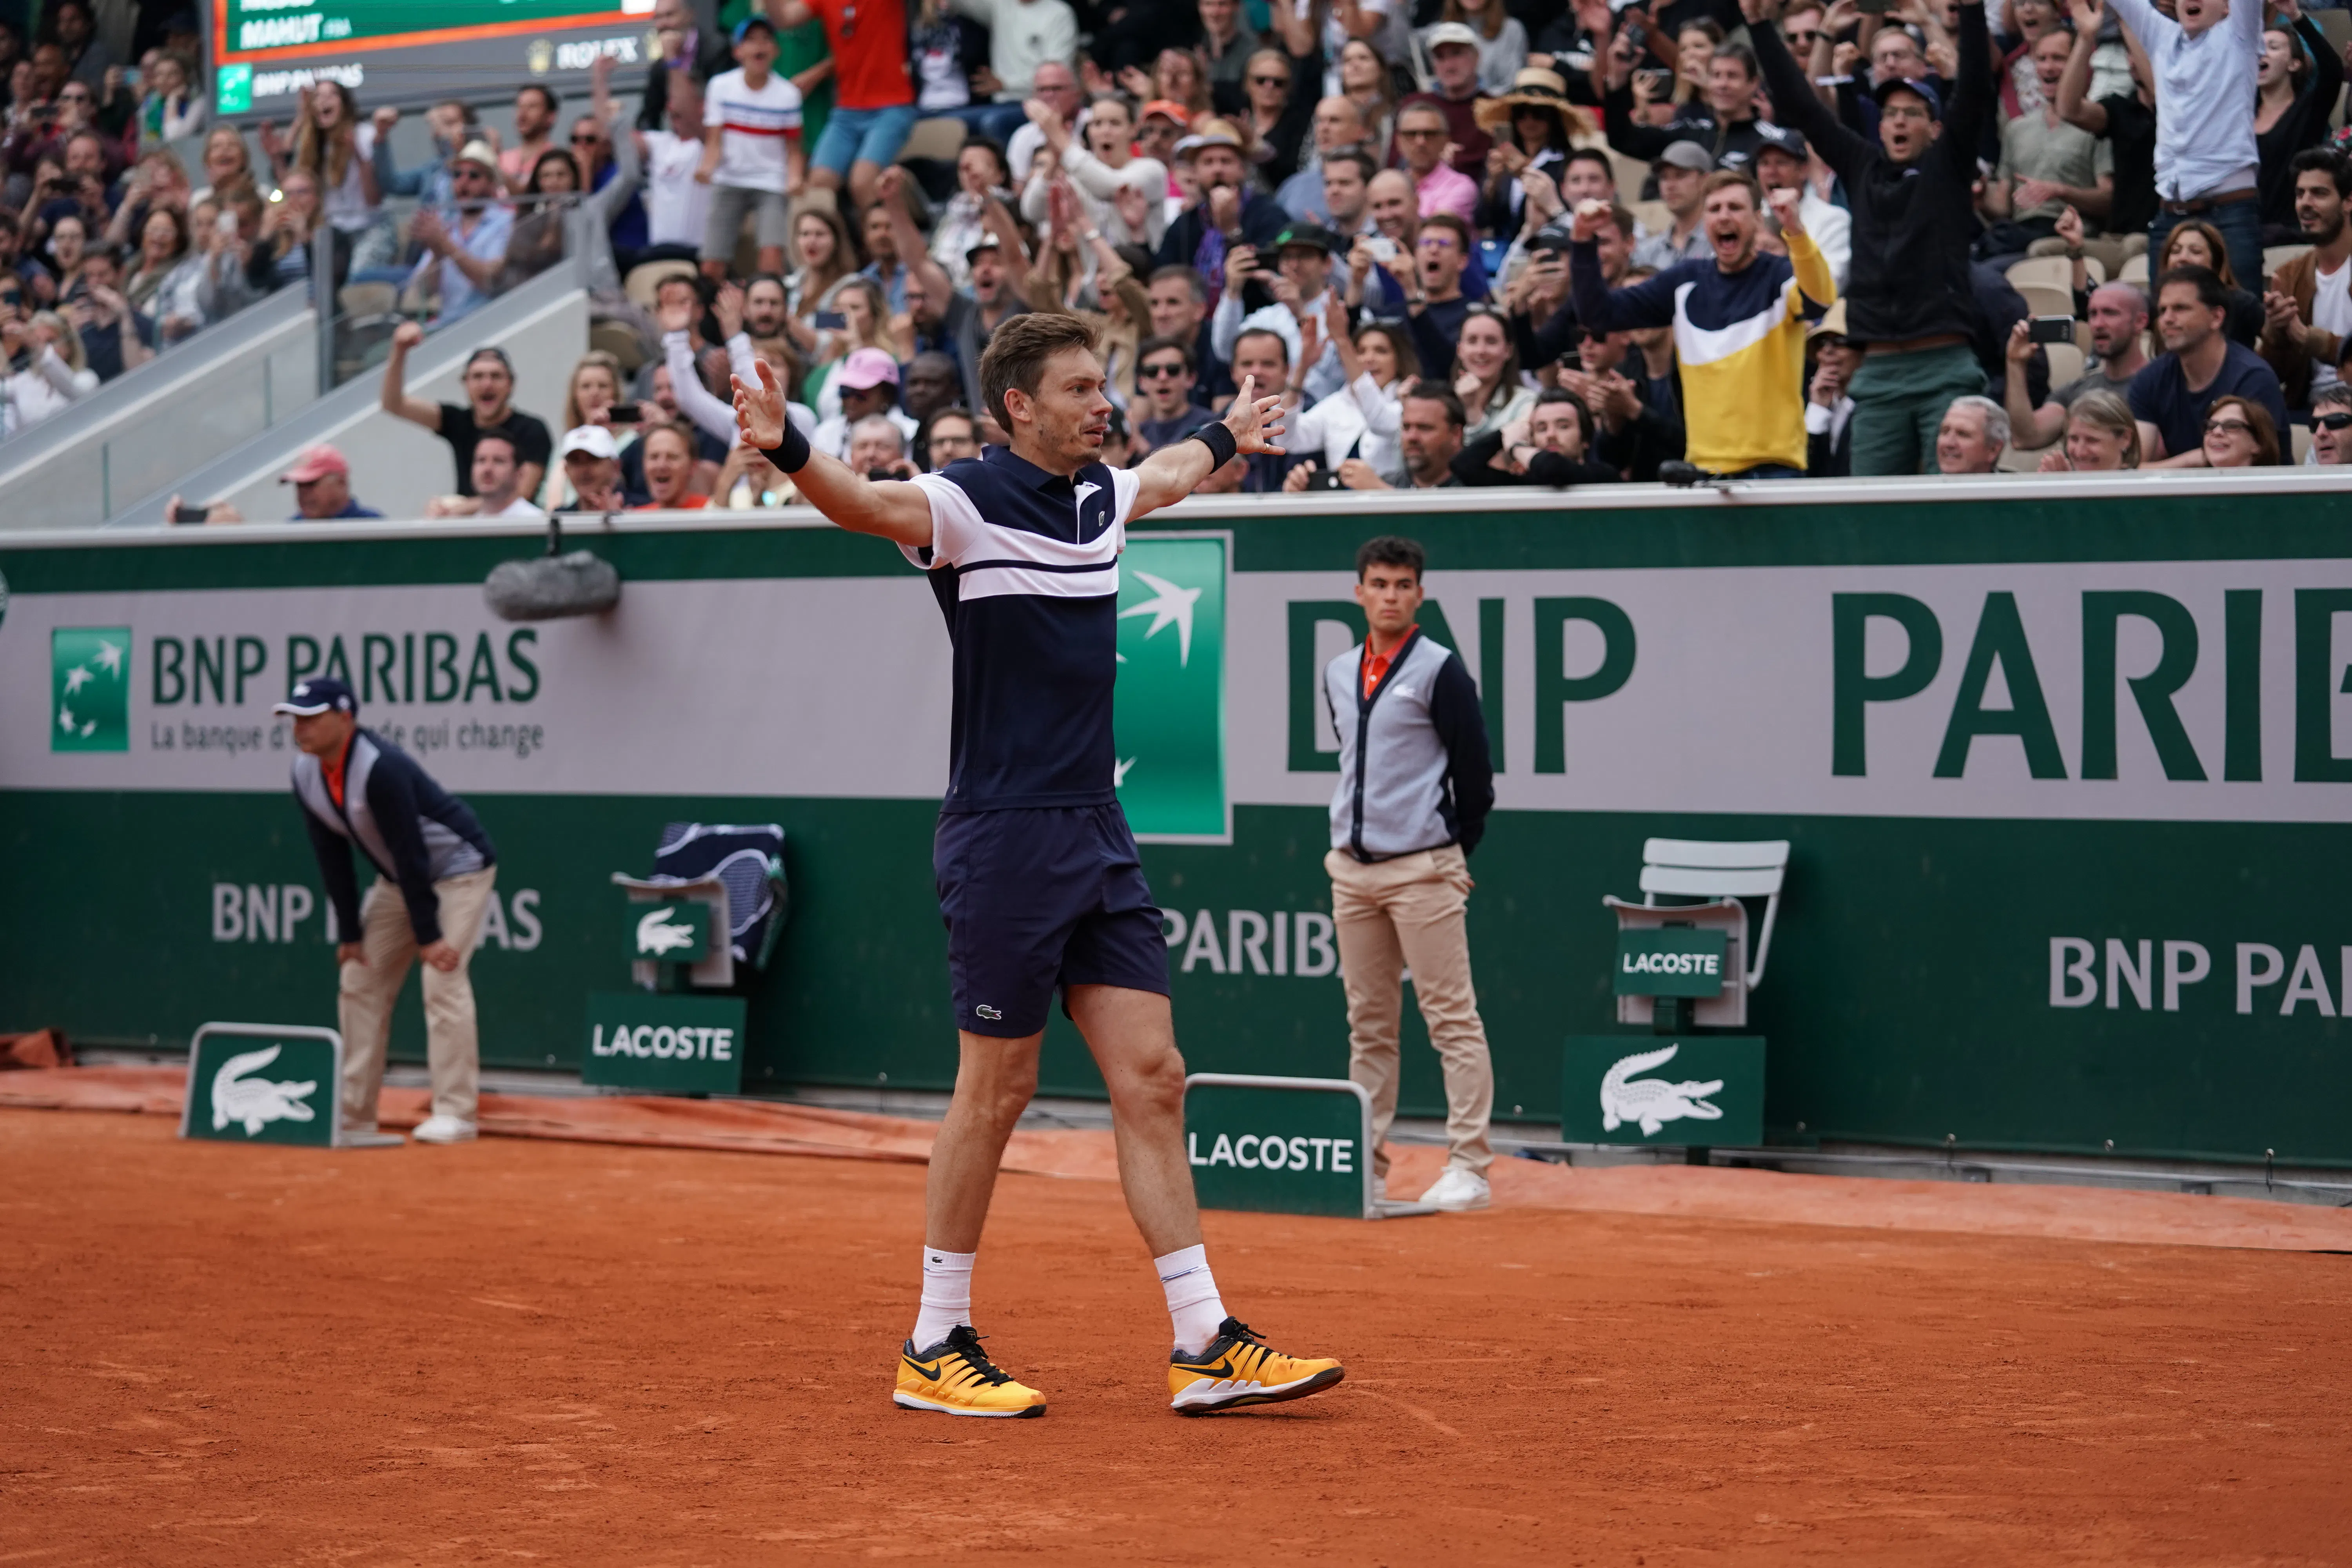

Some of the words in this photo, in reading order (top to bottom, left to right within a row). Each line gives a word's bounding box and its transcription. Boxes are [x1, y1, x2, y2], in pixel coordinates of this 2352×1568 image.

[153, 635, 268, 704] BNP
[287, 628, 541, 704] PARIBAS
[151, 720, 175, 750] La
[182, 720, 264, 759] banque
[413, 718, 450, 757] qui
[456, 717, 544, 759] change
[212, 883, 313, 942] BNP
[1622, 953, 1720, 975] LACOSTE
[2049, 936, 2211, 1011] BNP
[592, 1024, 734, 1061] LACOSTE
[1188, 1132, 1354, 1173] LACOSTE
